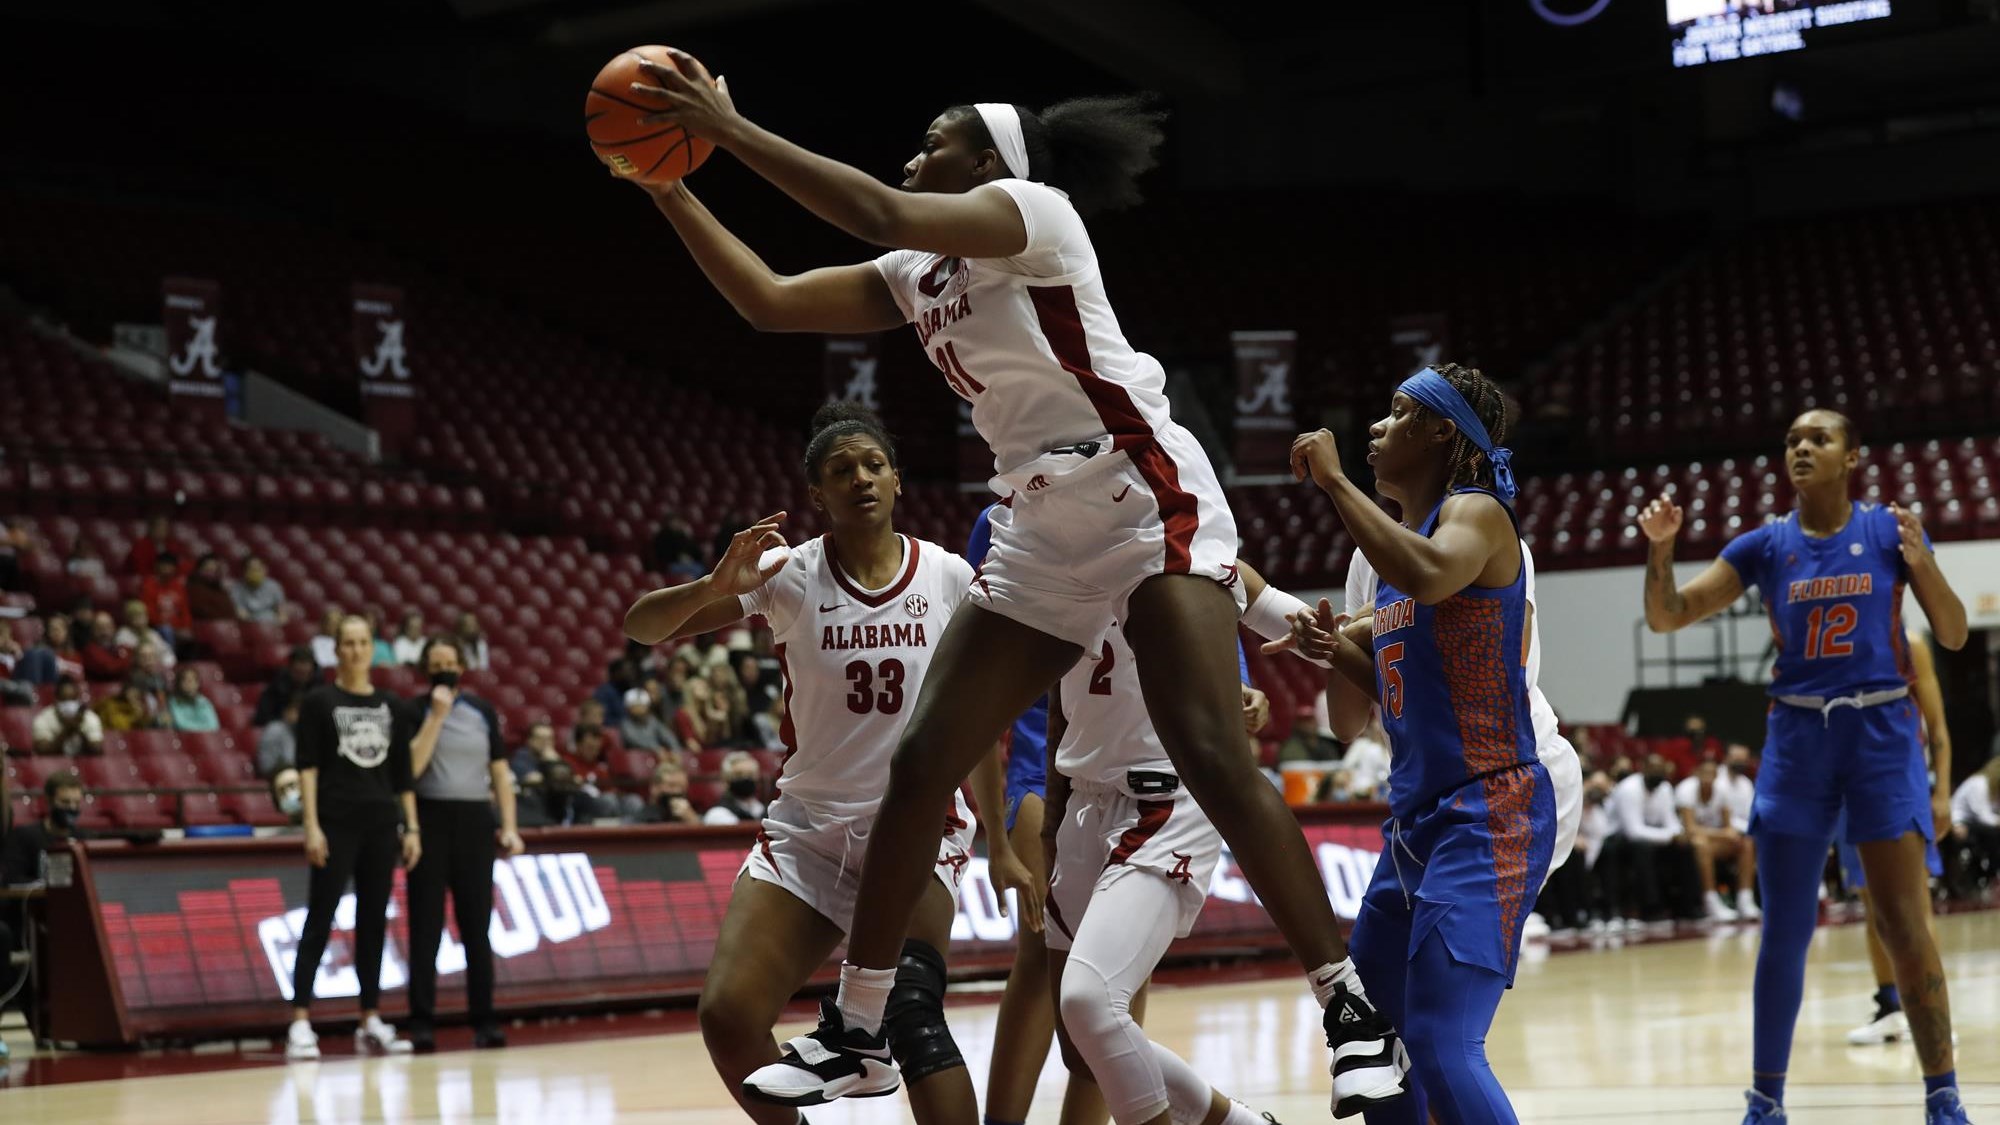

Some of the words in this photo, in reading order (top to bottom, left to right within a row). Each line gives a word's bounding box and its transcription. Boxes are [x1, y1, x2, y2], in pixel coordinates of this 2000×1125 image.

[906, 594, 927, 617] SEC
[1787, 573, 1873, 604] FLORIDA
[1373, 597, 1416, 638] ORIDA
[1804, 602, 1858, 660] 12
[821, 623, 928, 650] ALABAMA
[845, 658, 905, 715] 33
